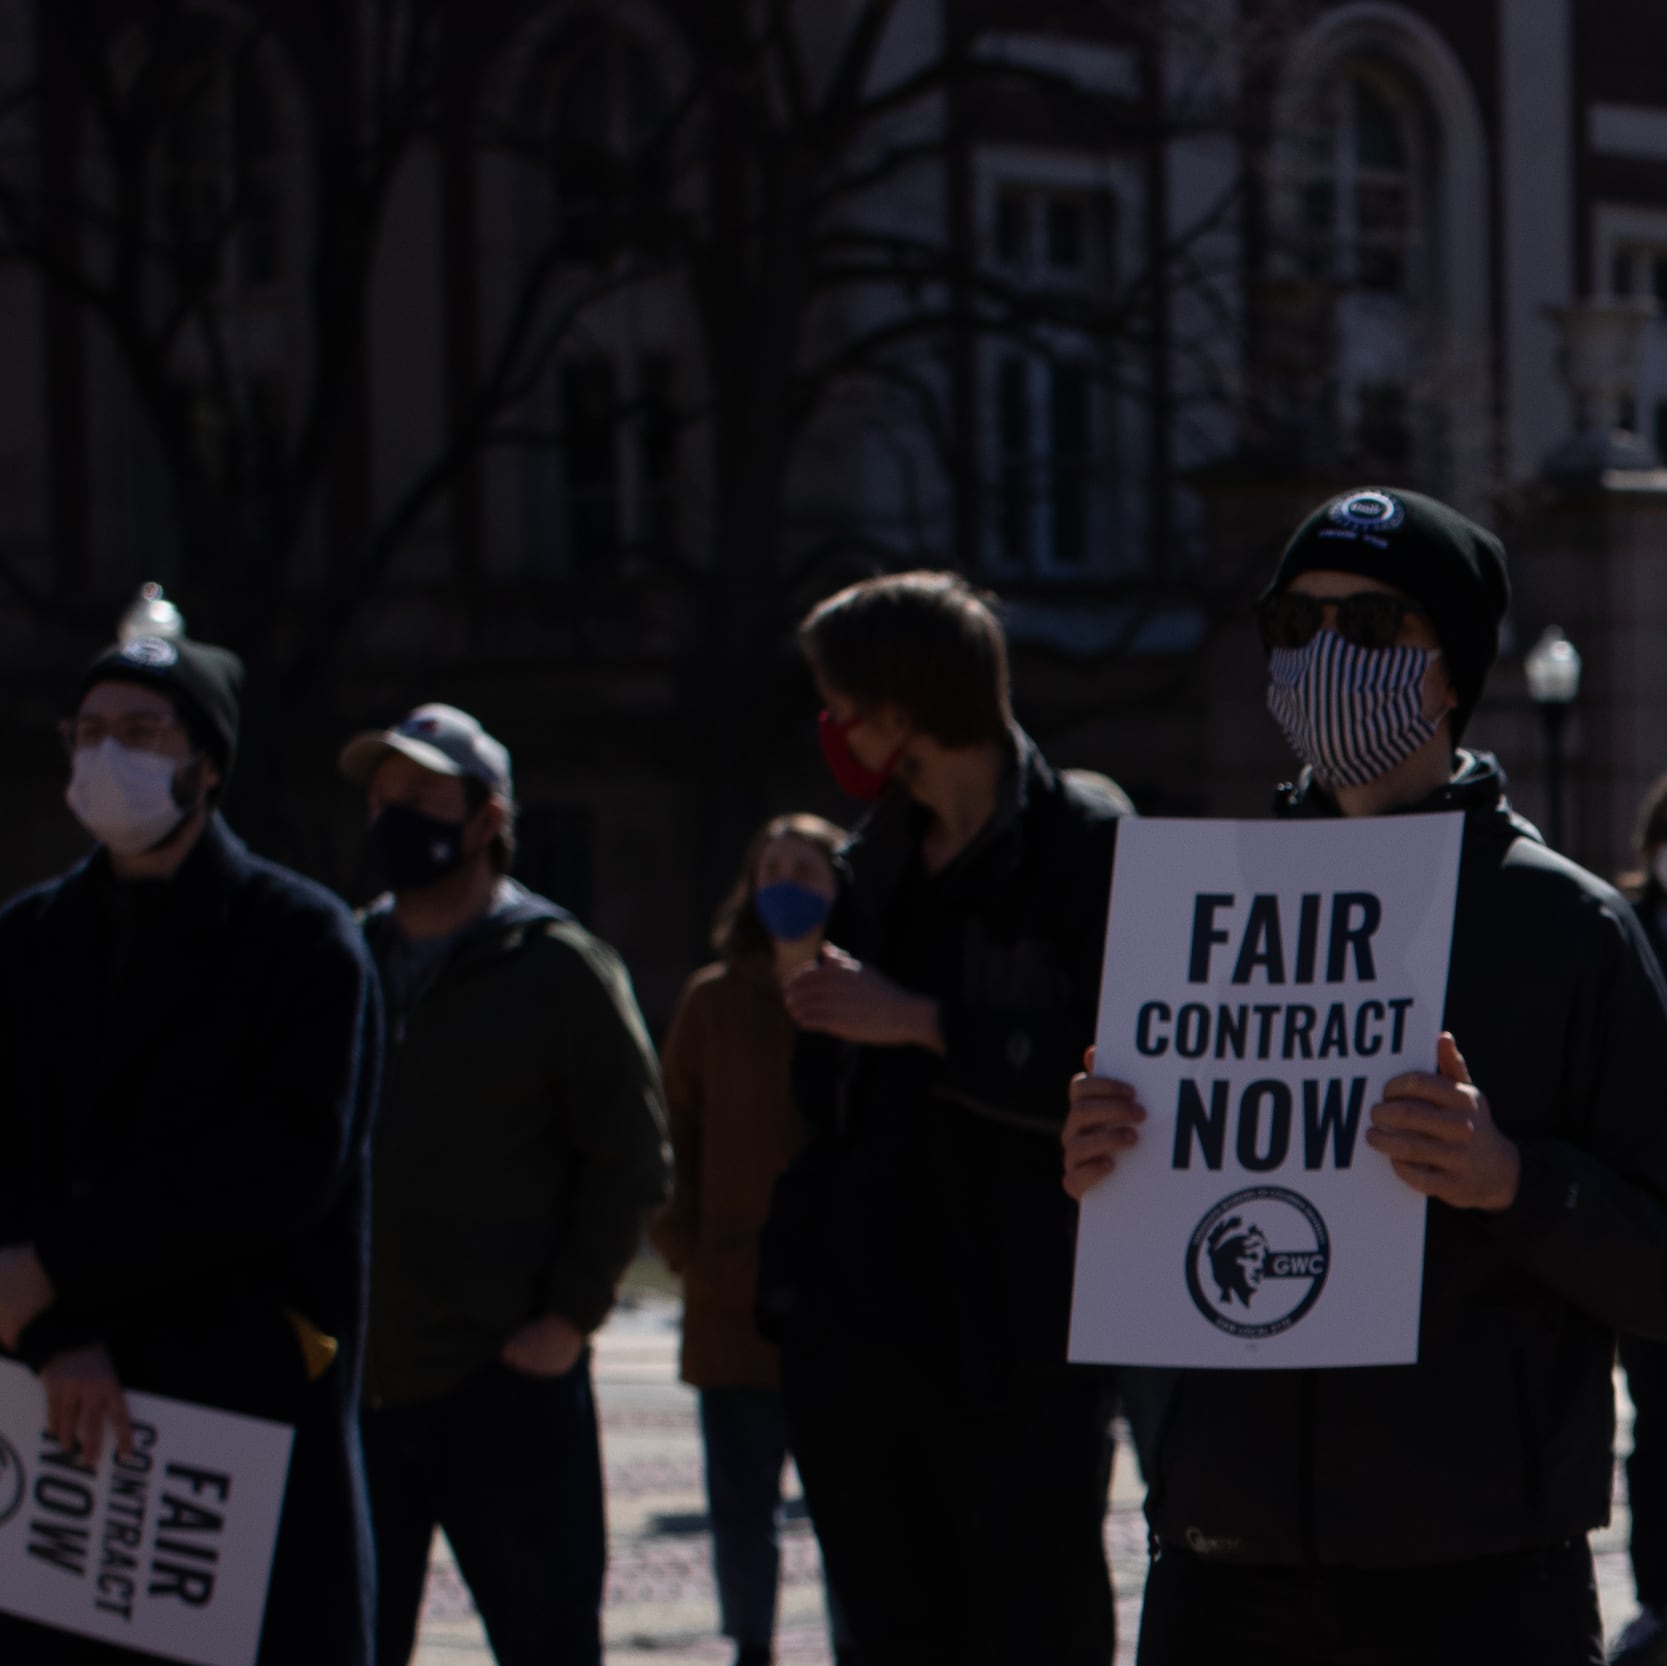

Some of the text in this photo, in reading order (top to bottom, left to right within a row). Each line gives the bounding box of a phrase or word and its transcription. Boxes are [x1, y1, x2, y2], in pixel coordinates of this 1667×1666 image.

[1188, 892, 1382, 985] FAIR
[1135, 998, 1414, 1060] CONTRACT
[1172, 1077, 1367, 1172] NOW
[1273, 1254, 1325, 1276] GWC
[96, 1423, 157, 1622] CONTRACT
[149, 1463, 229, 1607] FAIR
